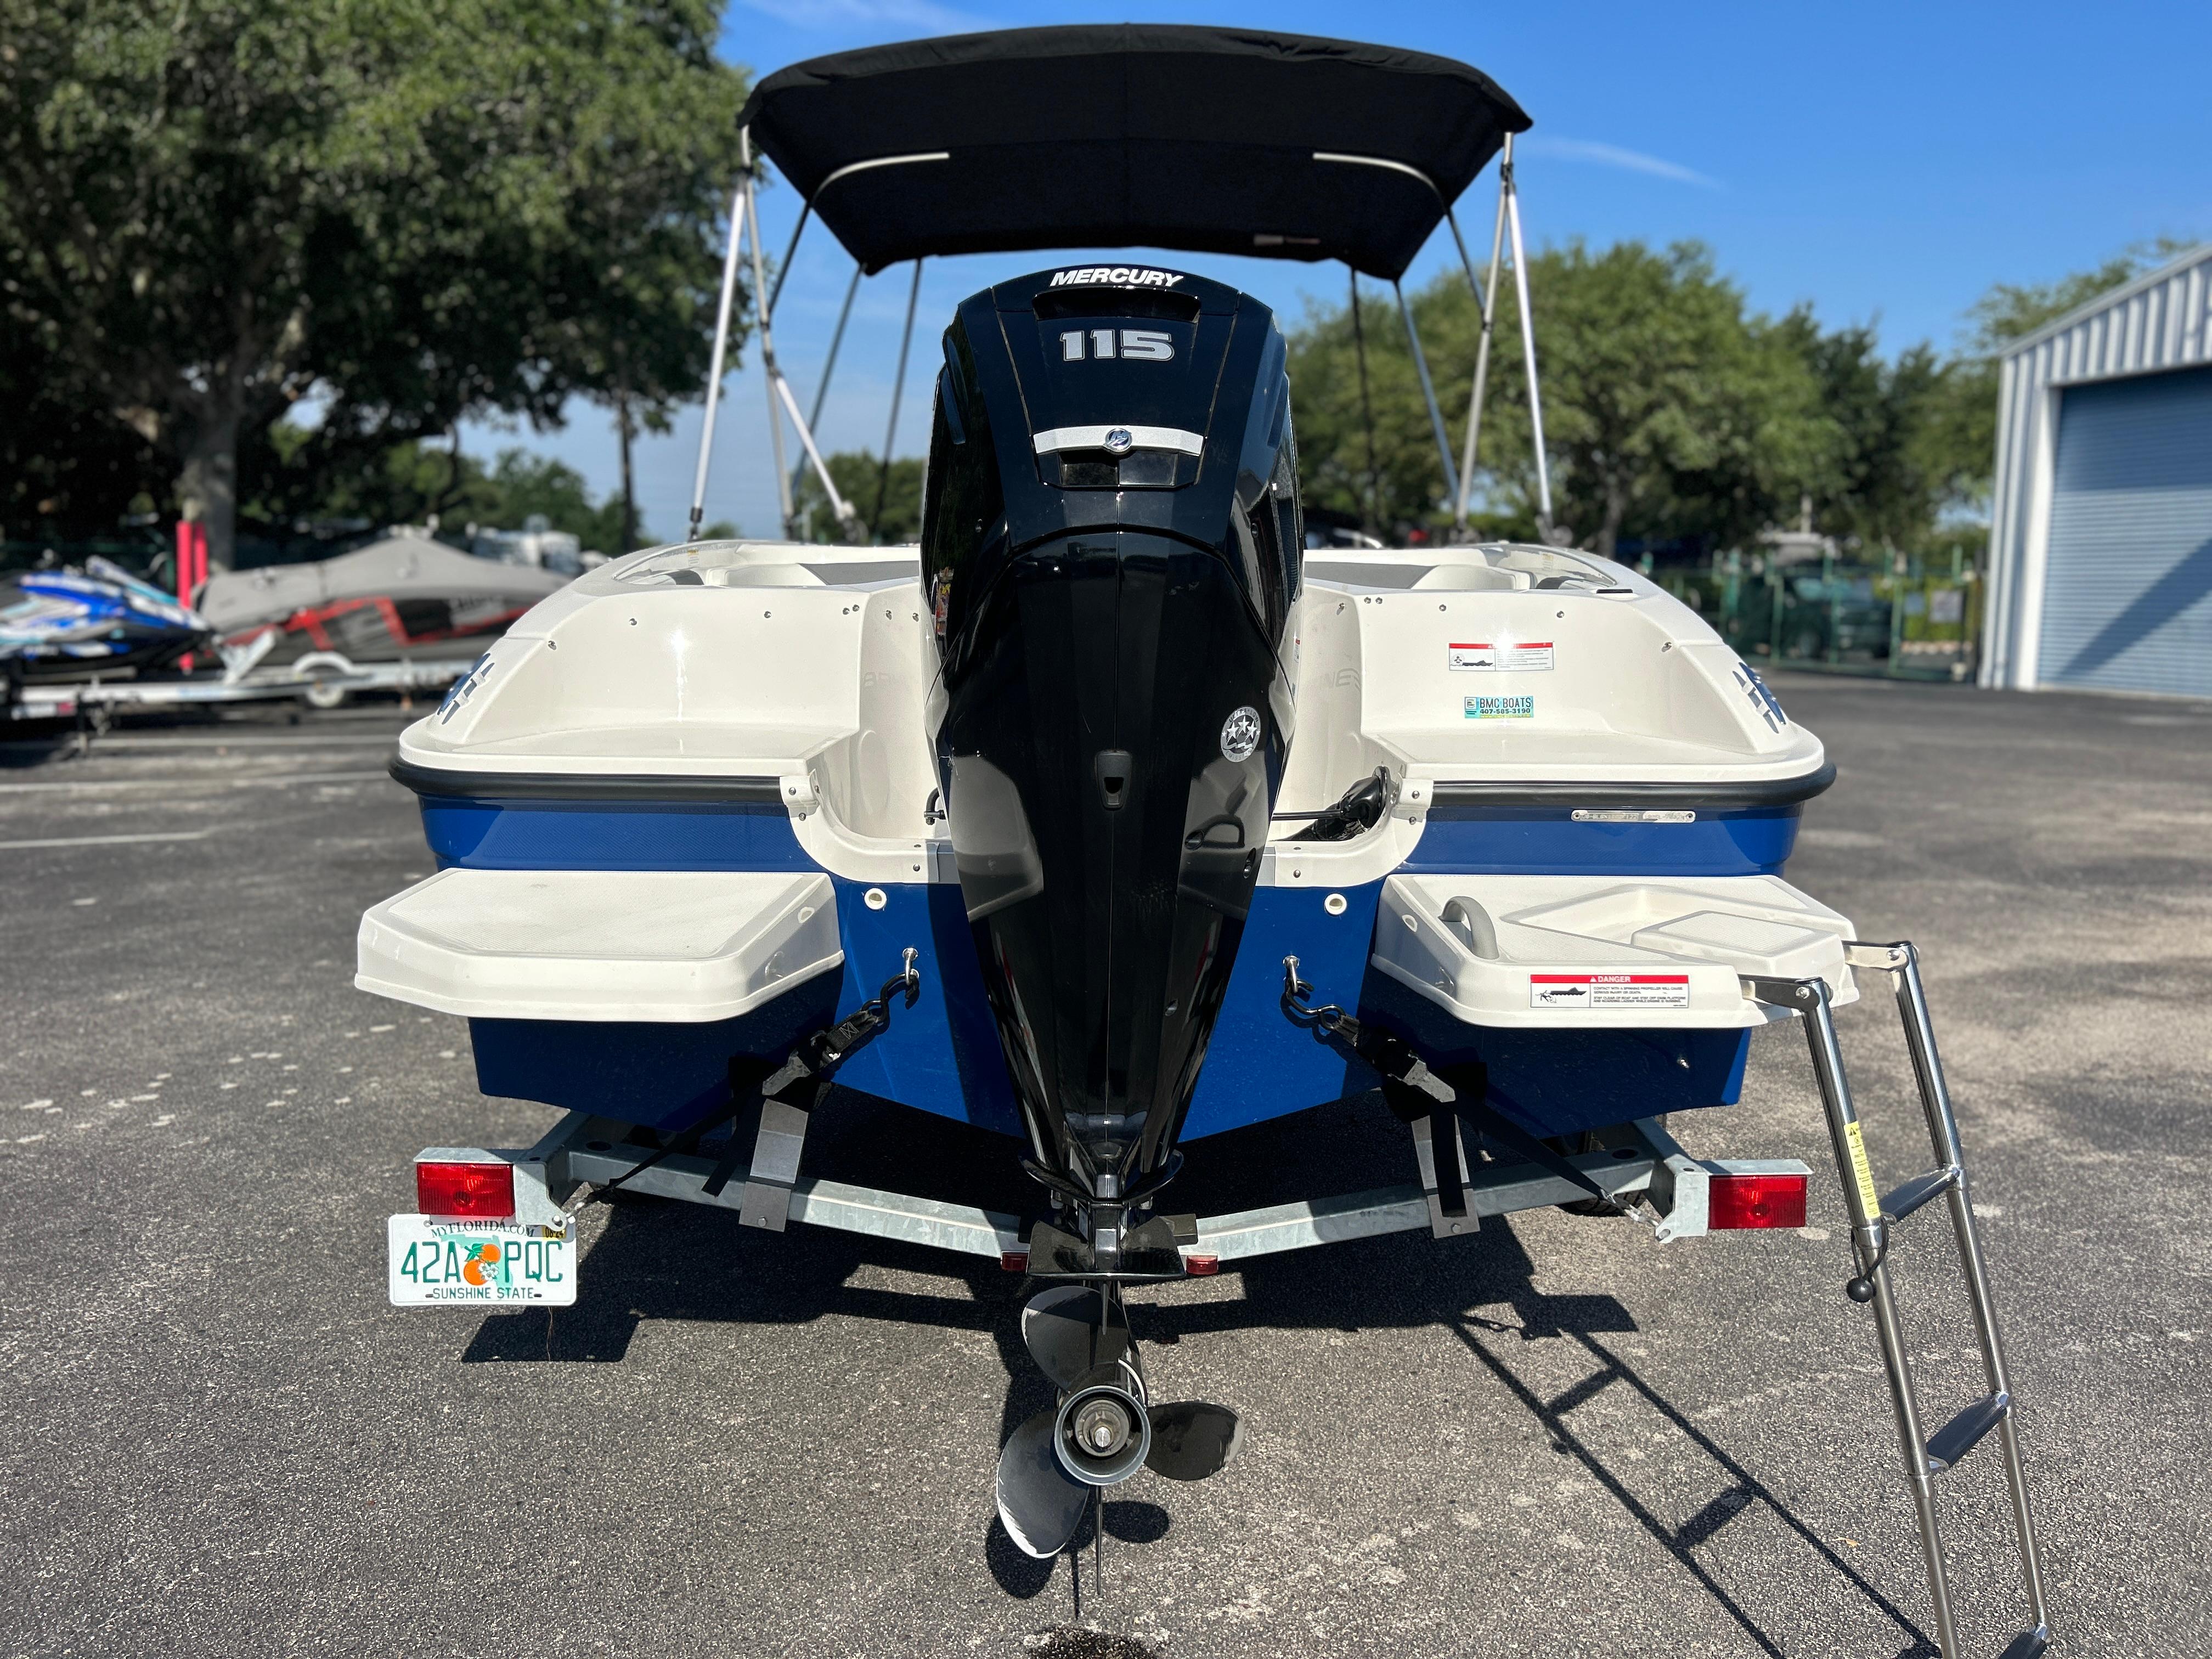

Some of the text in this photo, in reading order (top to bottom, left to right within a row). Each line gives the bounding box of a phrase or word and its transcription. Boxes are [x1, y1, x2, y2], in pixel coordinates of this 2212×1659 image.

[1049, 268, 1184, 286] MERCURY
[1059, 329, 1175, 362] 115
[1480, 698, 1499, 708] BMC
[1503, 697, 1531, 708] BOATS
[431, 1220, 535, 1238] MYFLORIDA.COM
[401, 1240, 563, 1283] 42A PQC
[432, 1287, 534, 1299] SUNSHINE STATE
